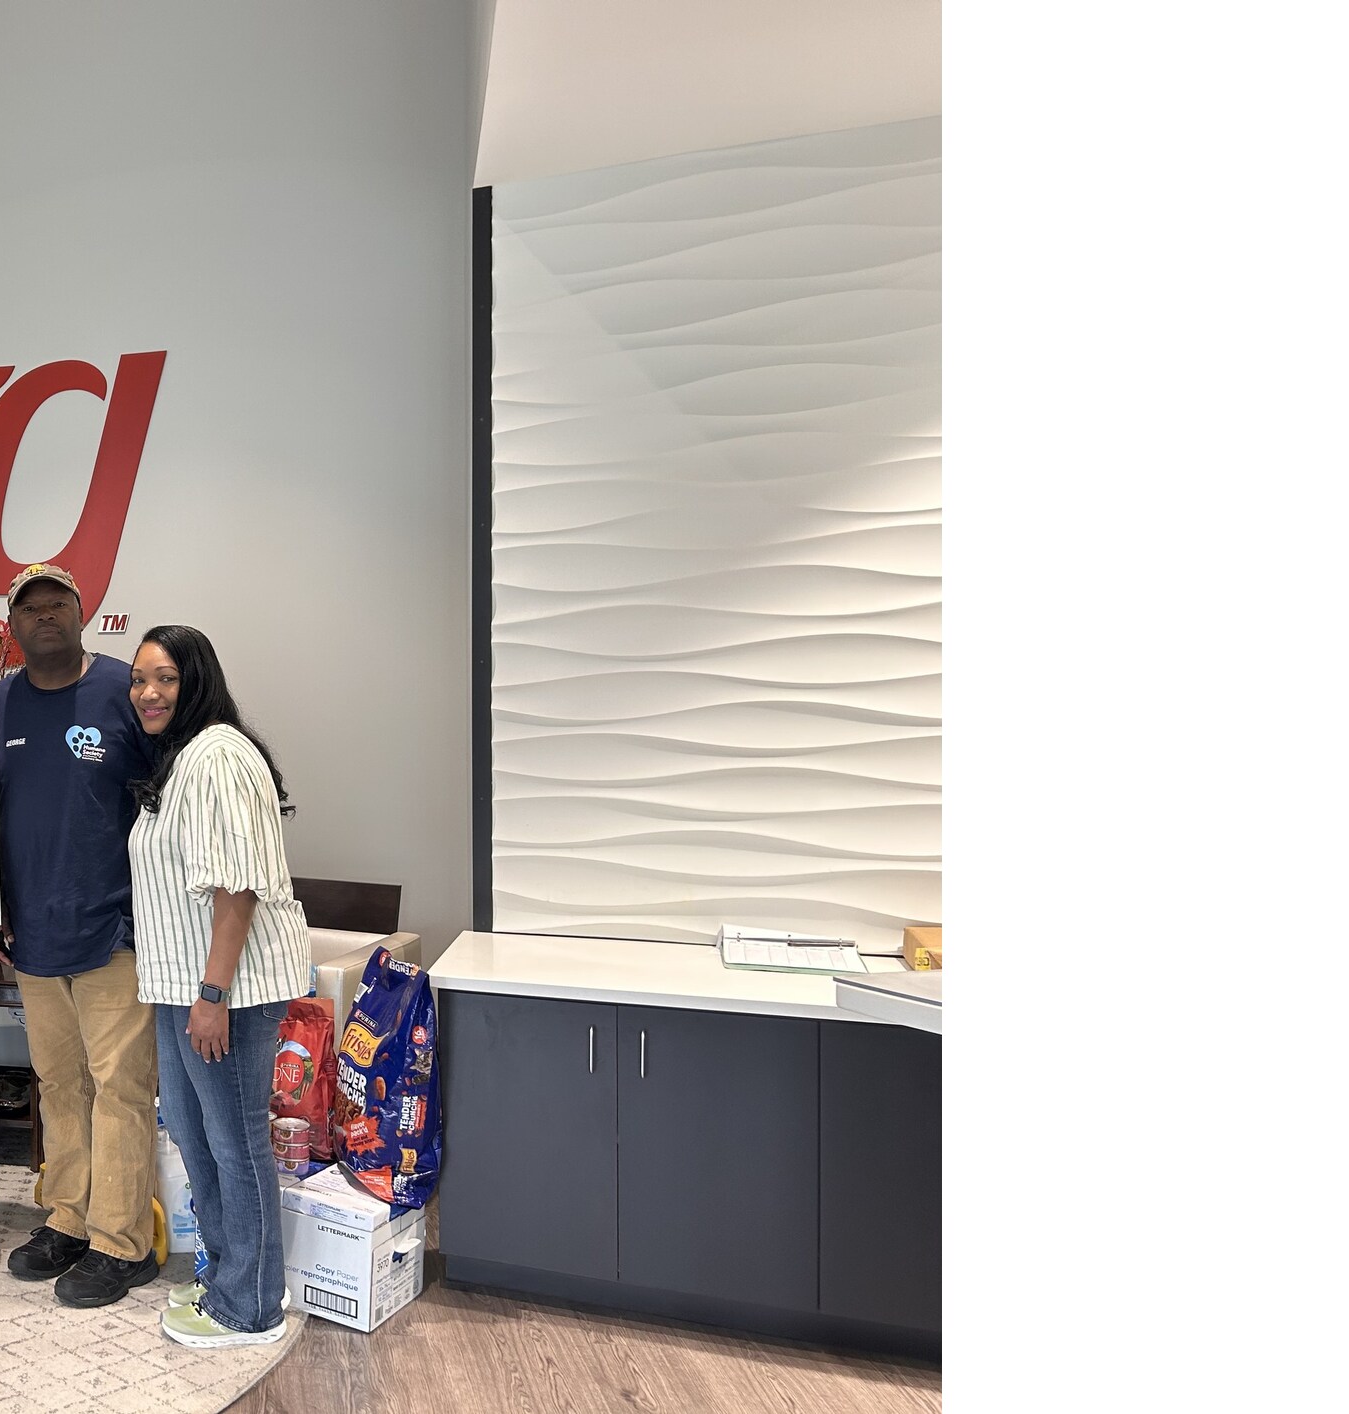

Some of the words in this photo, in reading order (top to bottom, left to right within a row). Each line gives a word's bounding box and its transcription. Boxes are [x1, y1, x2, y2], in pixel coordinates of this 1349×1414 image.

[100, 614, 129, 633] TM
[5, 737, 27, 748] GEORGE
[83, 745, 106, 753] Humane
[82, 750, 103, 758] Society
[358, 1012, 377, 1028] PURINA
[337, 1057, 367, 1093] TENDER
[400, 1096, 411, 1130] TENDER
[317, 1224, 360, 1241] LETTERMARK
[315, 1263, 335, 1277] Copy
[336, 1269, 359, 1282] Paper
[377, 1258, 389, 1273] 3970
[300, 1269, 359, 1292] reprographique
